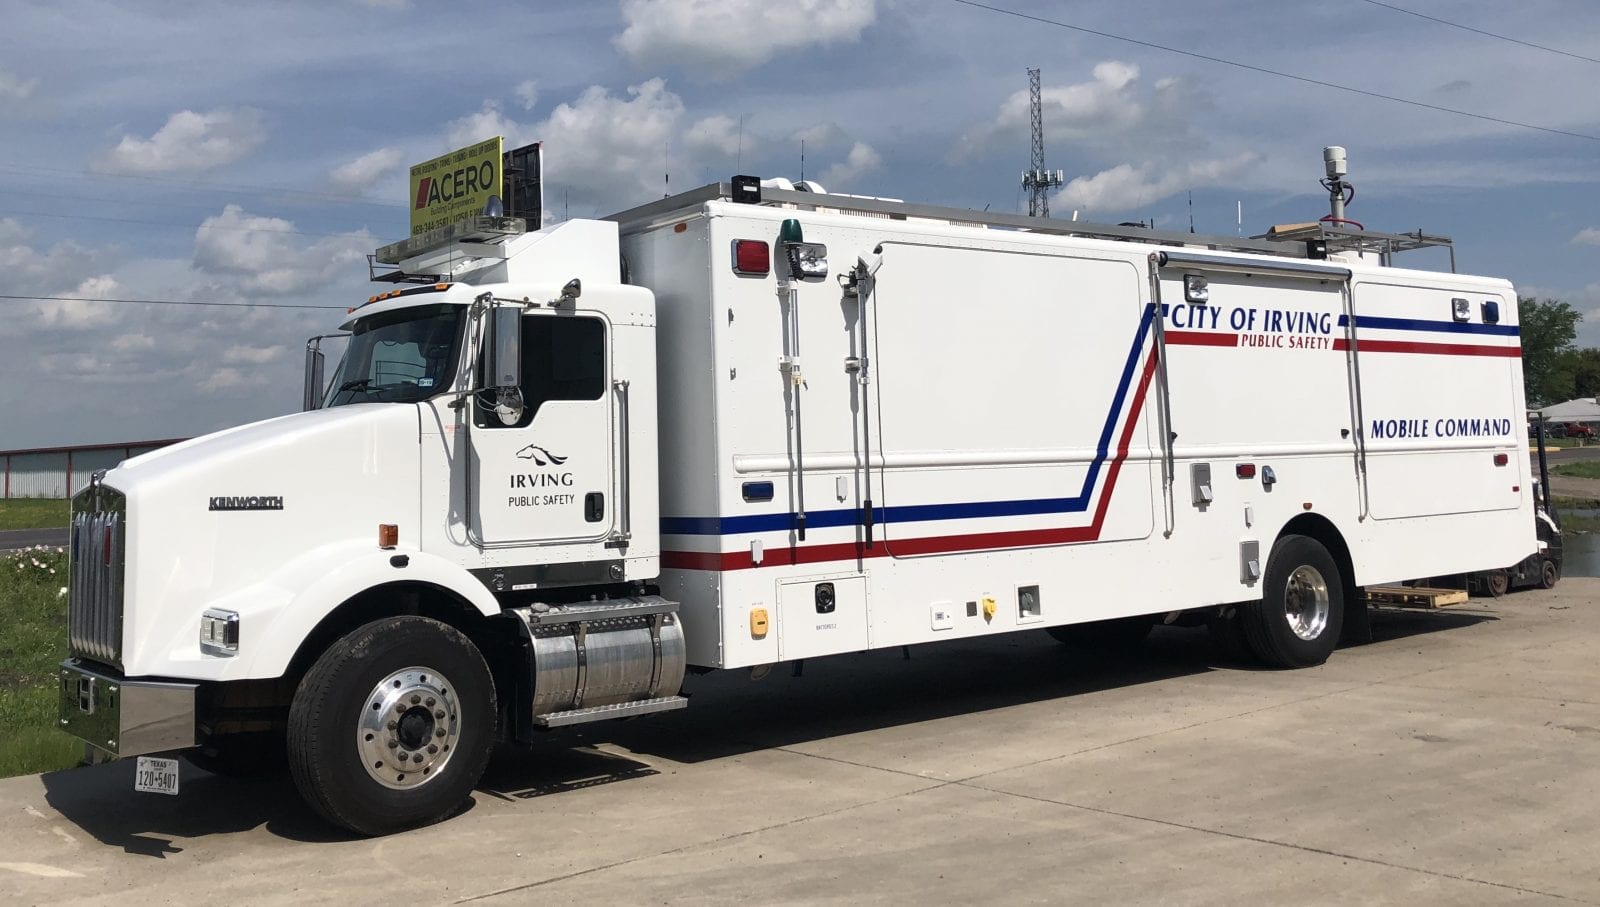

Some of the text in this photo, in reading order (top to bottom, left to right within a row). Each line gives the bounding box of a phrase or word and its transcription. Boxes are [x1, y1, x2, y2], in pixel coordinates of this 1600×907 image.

[428, 161, 493, 207] ACERO
[431, 197, 475, 216] Building Components
[1171, 304, 1331, 335] CITY OF IRVING
[1241, 334, 1331, 350] PUBLIC SAFETY
[1371, 418, 1511, 439] MOBILE COMMAND
[511, 473, 573, 488] IRVING
[209, 496, 283, 510] KENWORTH
[508, 494, 575, 507] PUBLIC SAFETY
[151, 760, 167, 768] TEXAS
